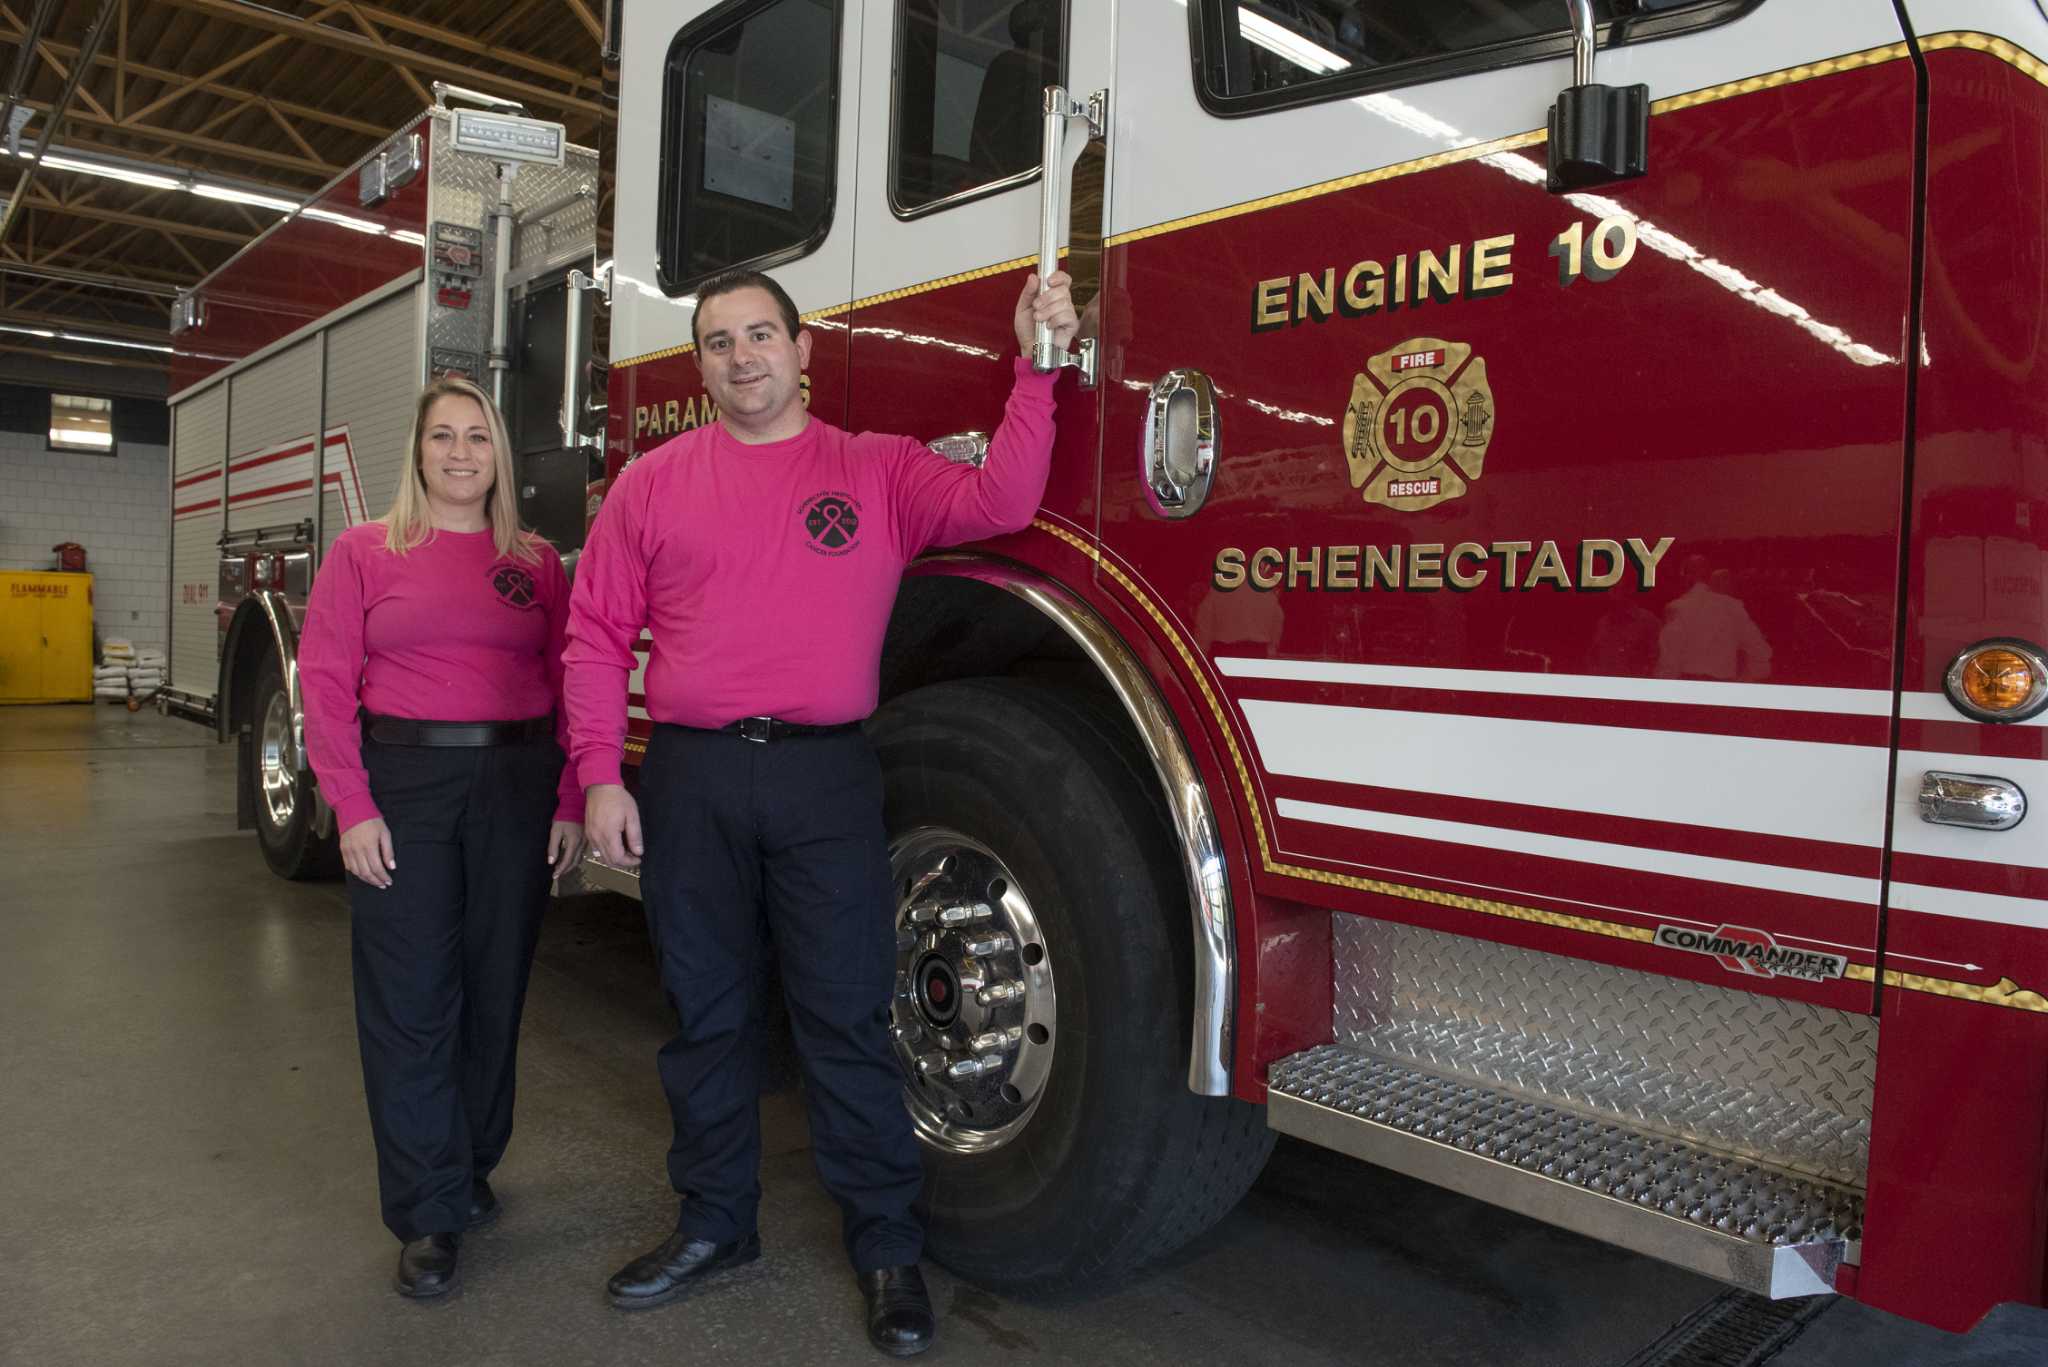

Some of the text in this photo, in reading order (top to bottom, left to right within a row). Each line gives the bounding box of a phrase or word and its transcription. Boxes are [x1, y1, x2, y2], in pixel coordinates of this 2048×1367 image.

[1253, 213, 1638, 331] ENGINE 10
[1400, 351, 1436, 369] FIRE
[1389, 404, 1441, 446] 10
[1389, 480, 1439, 497] RESCUE
[1213, 537, 1676, 592] SCHENECTADY
[10, 583, 69, 594] FLAMMABLE
[1659, 926, 1840, 975] COMMANDER
